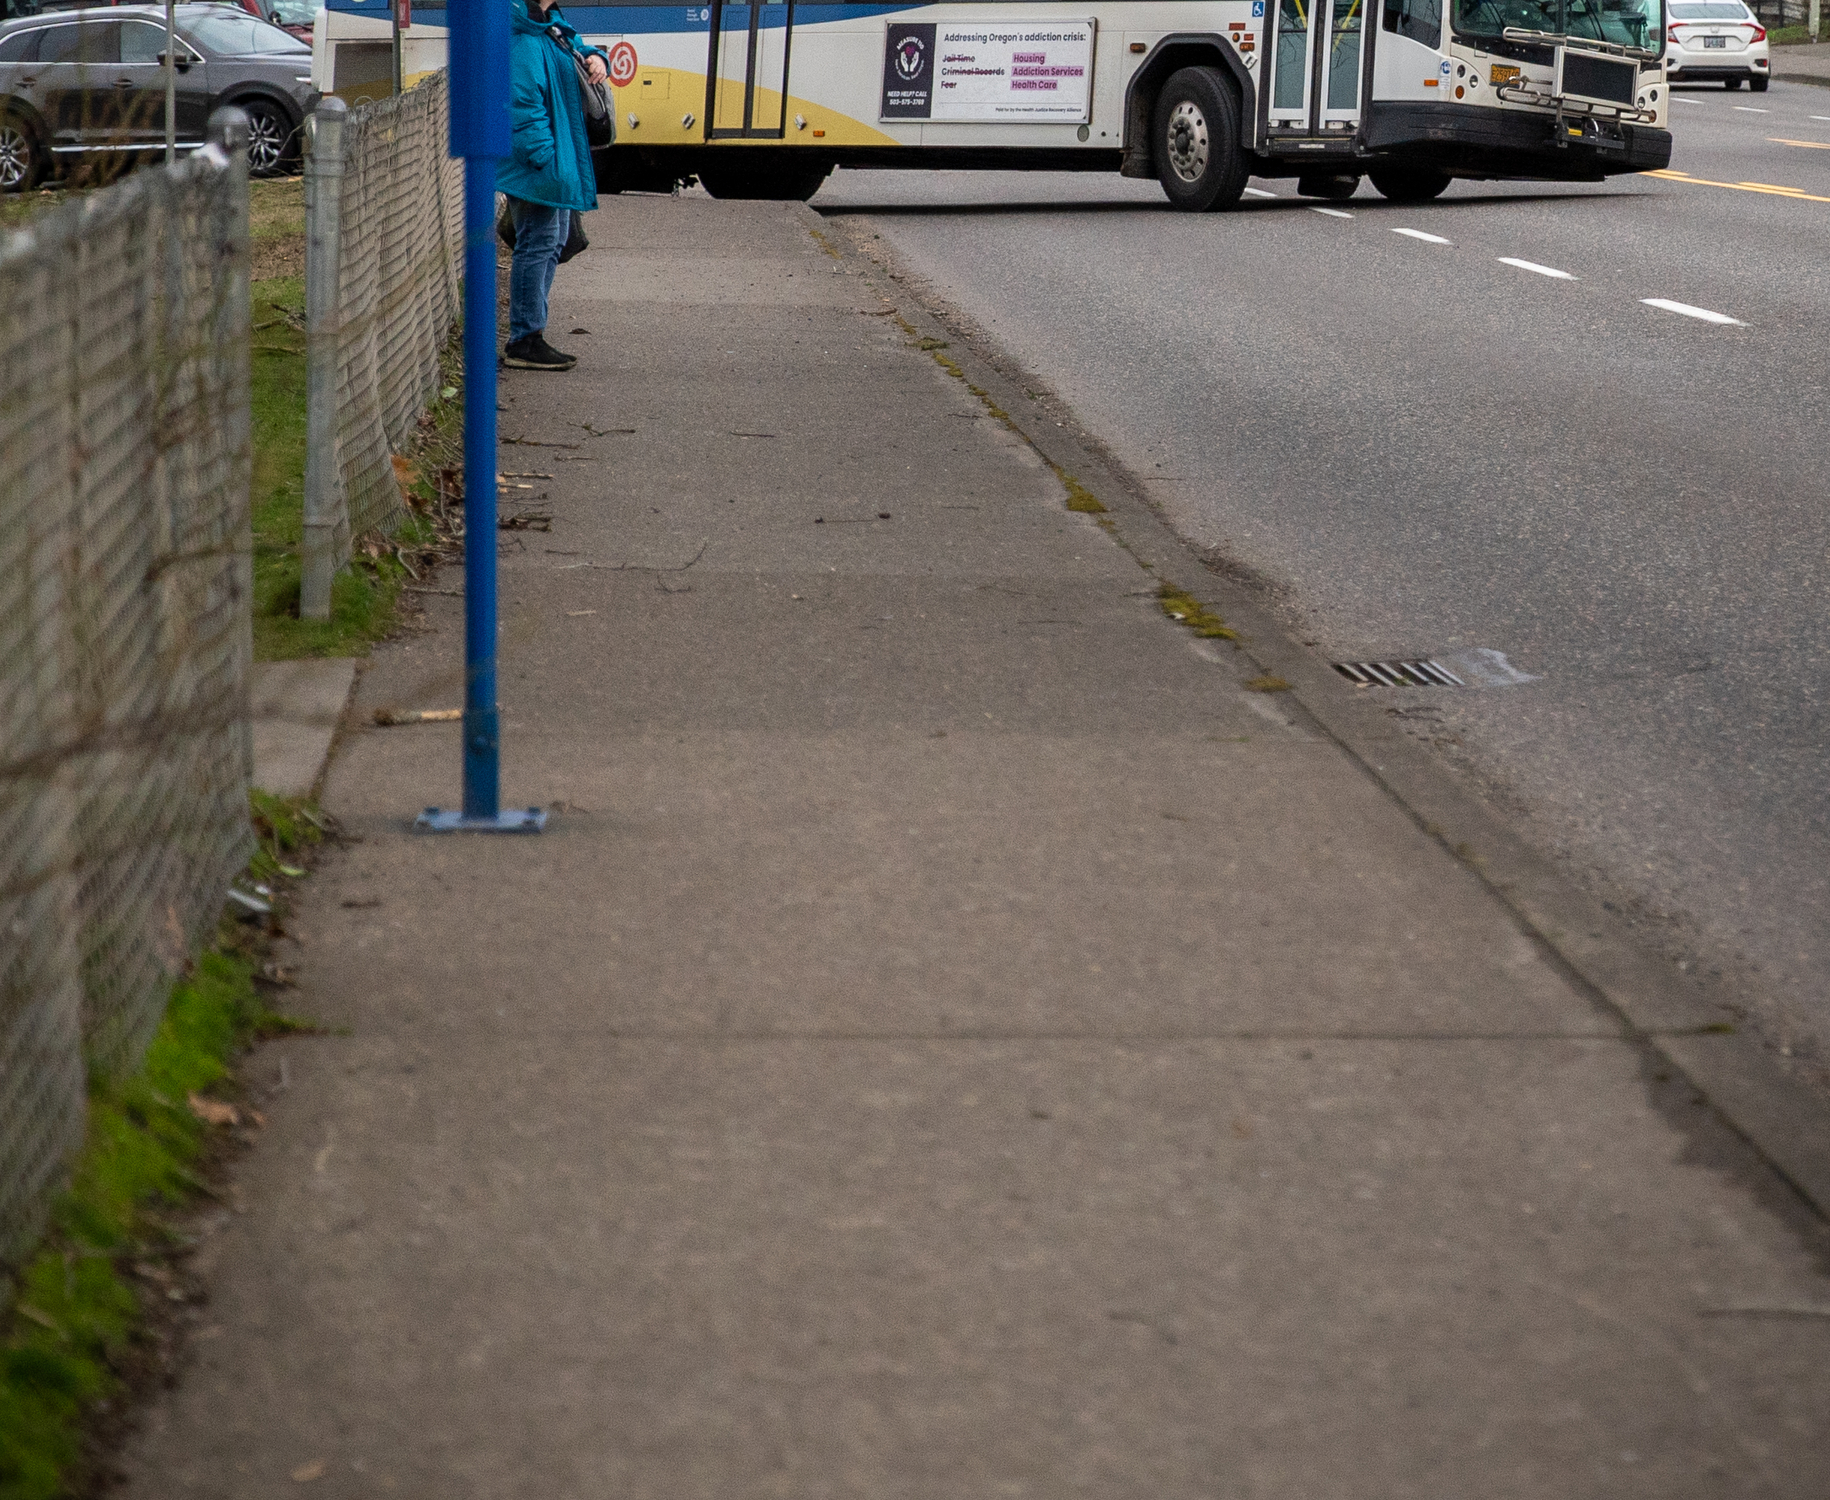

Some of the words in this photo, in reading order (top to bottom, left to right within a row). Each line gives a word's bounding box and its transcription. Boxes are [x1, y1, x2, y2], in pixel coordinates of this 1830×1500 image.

[944, 32, 987, 44] Addressing
[989, 32, 1023, 44] Oregon's
[1024, 32, 1062, 41] addiction
[1063, 32, 1086, 41] crisis:
[942, 54, 956, 62] Jail
[957, 54, 976, 62] Time
[1013, 53, 1045, 65] Housing
[941, 67, 974, 75] Criminal
[1012, 67, 1050, 76] Addiction
[1051, 67, 1084, 76] Services
[941, 80, 957, 89] Fear
[1012, 80, 1037, 89] Health
[1038, 80, 1057, 89] Care
